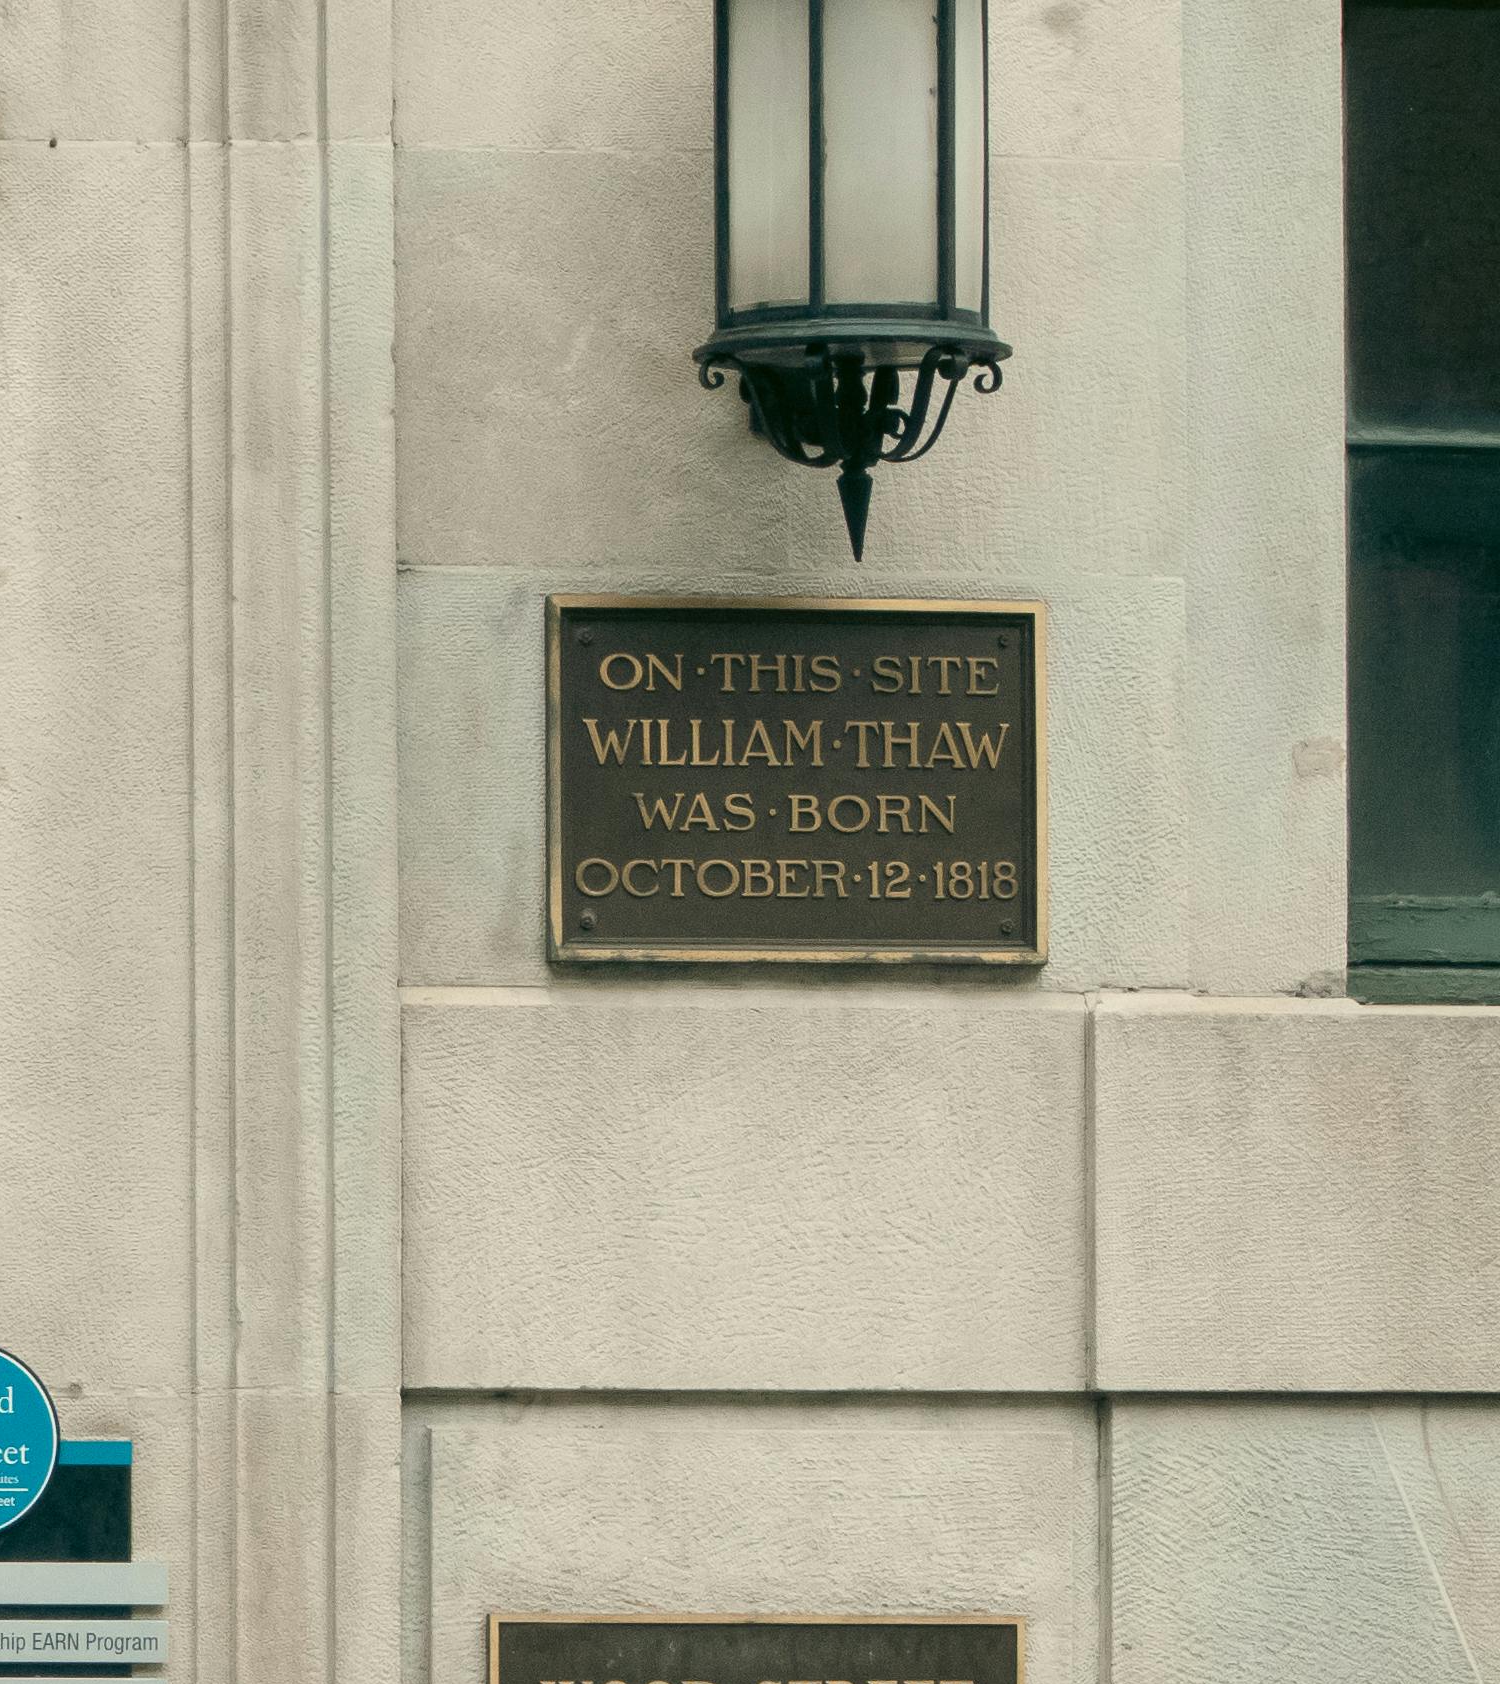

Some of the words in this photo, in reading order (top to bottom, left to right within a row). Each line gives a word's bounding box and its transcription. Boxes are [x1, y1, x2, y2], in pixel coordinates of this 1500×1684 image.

[599, 653, 684, 691] ON
[871, 656, 999, 696] SITE
[583, 719, 824, 767] WILLIAM
[845, 720, 1010, 770] THAW
[632, 792, 756, 832] WAS
[788, 795, 956, 833] BORN
[32, 1632, 79, 1651] EARN
[86, 1633, 159, 1655] Program
